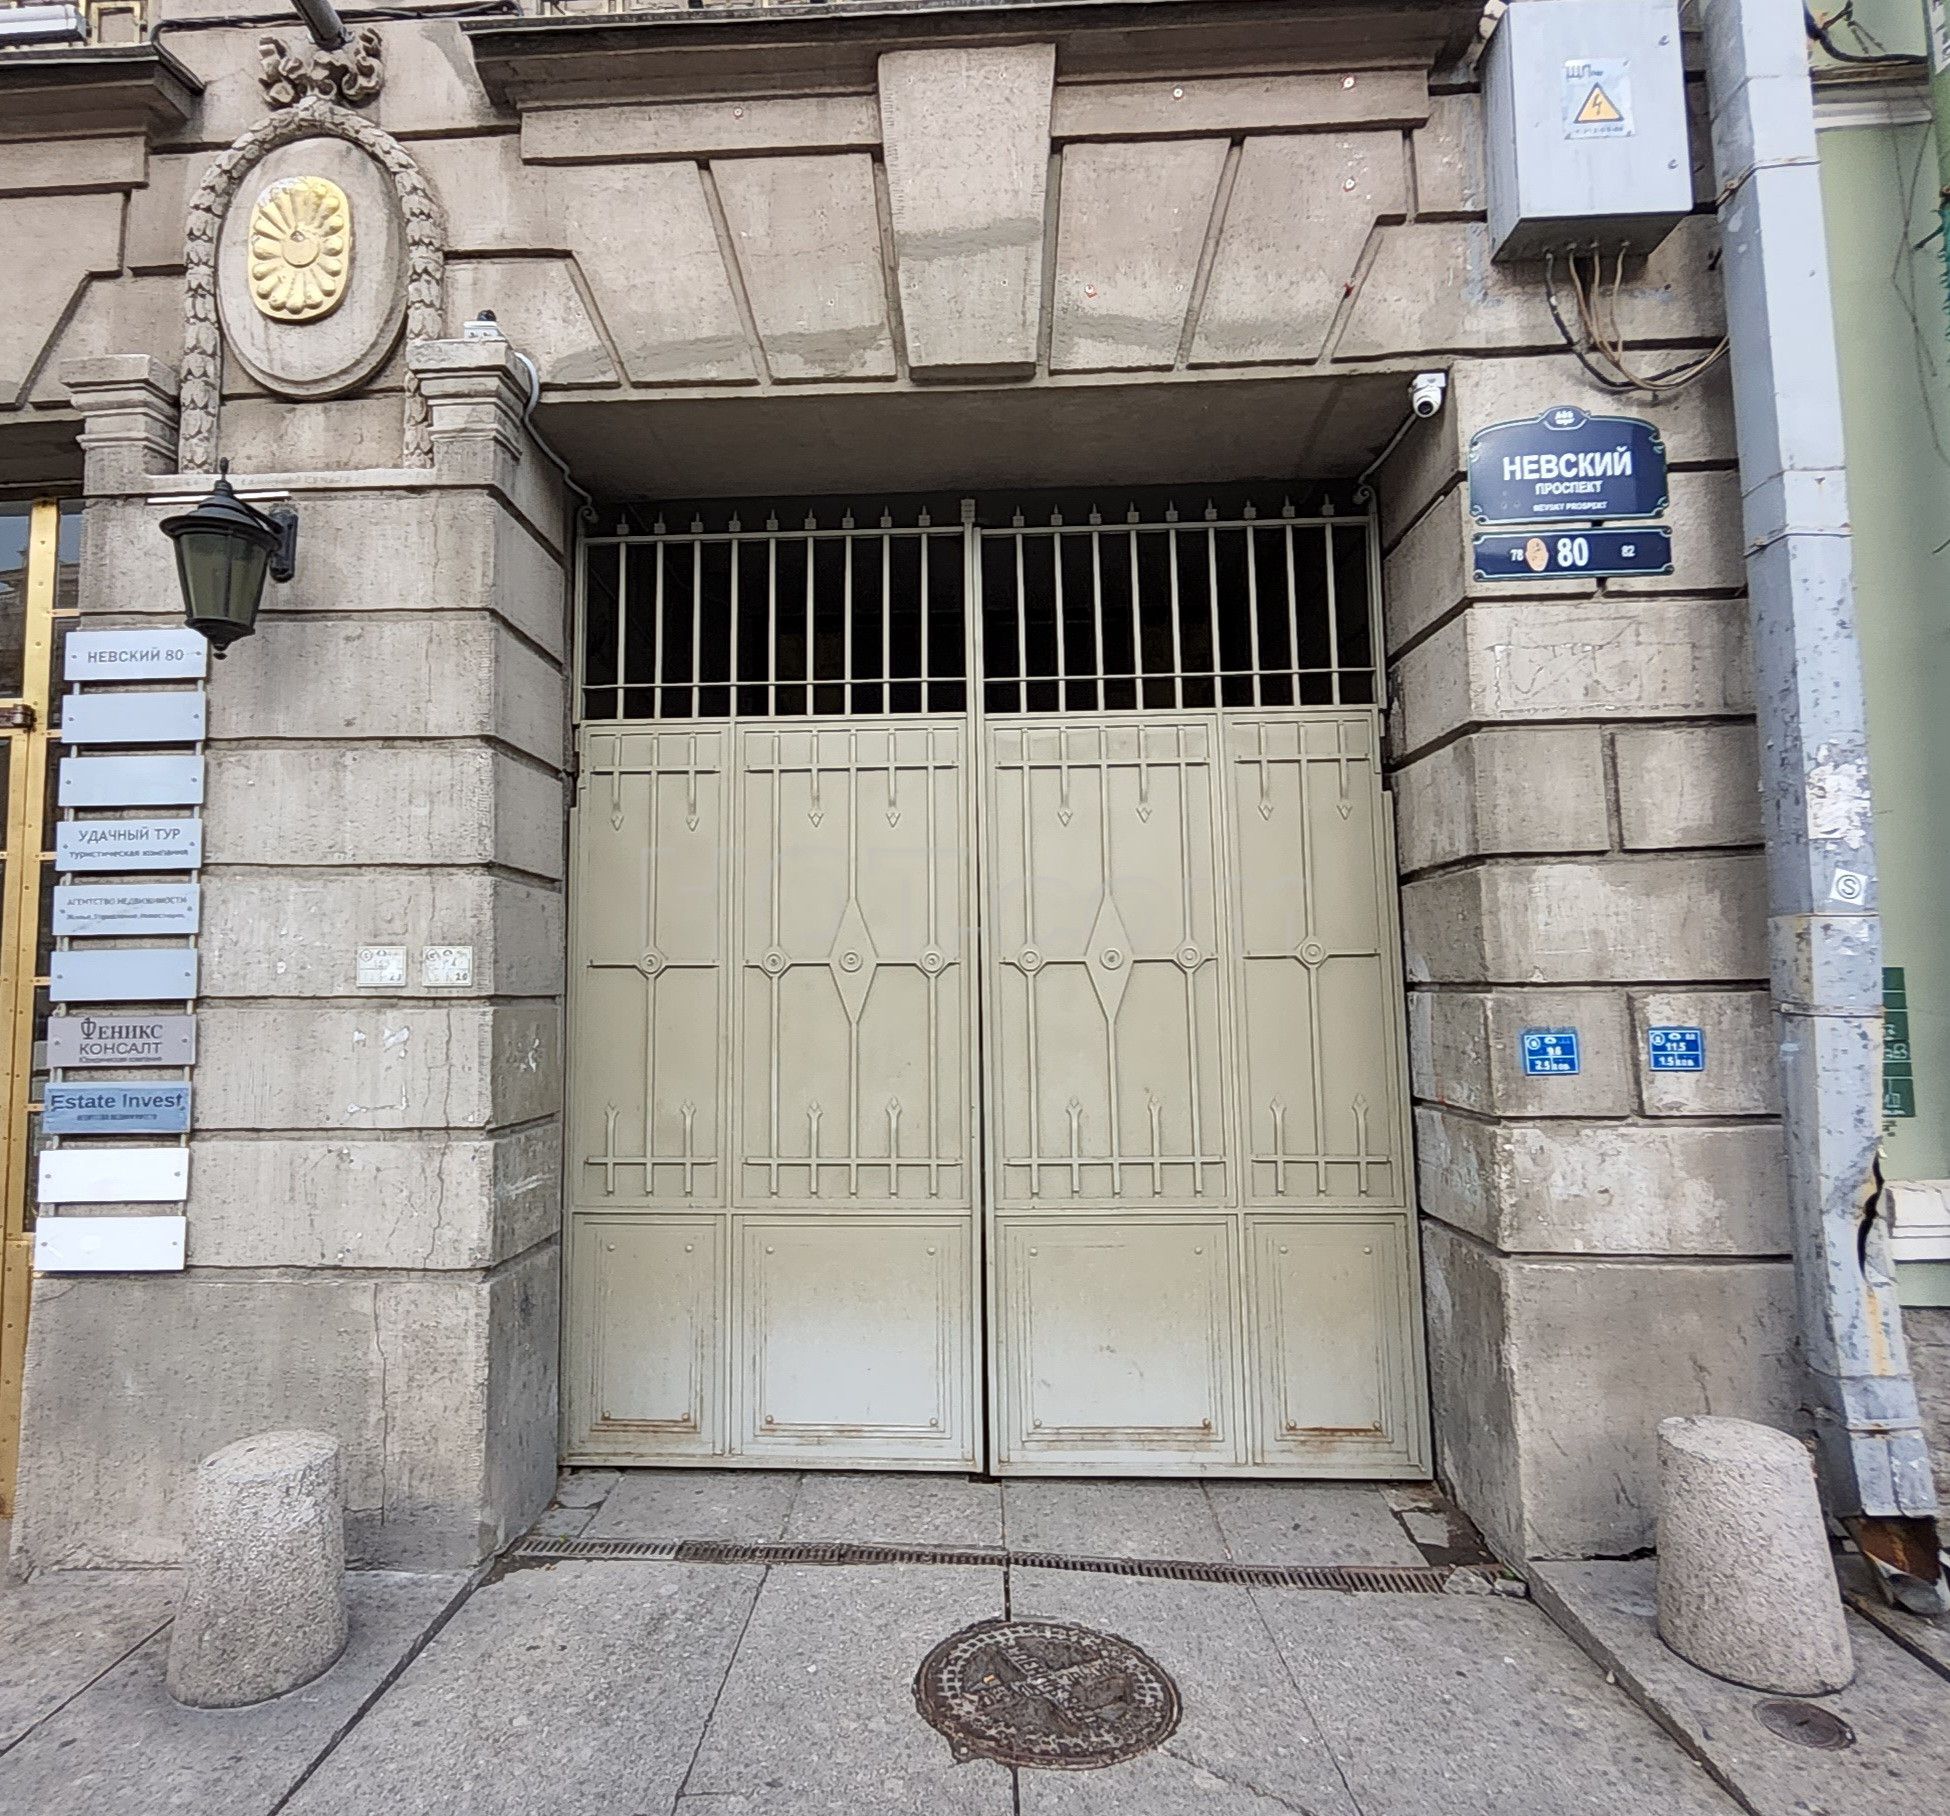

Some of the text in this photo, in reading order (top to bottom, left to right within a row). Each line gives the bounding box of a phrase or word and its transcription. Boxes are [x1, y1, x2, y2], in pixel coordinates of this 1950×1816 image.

[1502, 446, 1633, 480] НЕВСКИЙ
[1535, 480, 1604, 495] ПРОСПЕКТ
[1510, 537, 1636, 567] 78 80 82
[87, 647, 184, 663] НЕВСКИЙ 80
[78, 826, 181, 844] УДАЧНЫЙ ТУР
[69, 851, 140, 860] туристическая
[79, 1042, 163, 1055] КОНСАЛТ
[51, 1093, 183, 1110] Estate Invest
